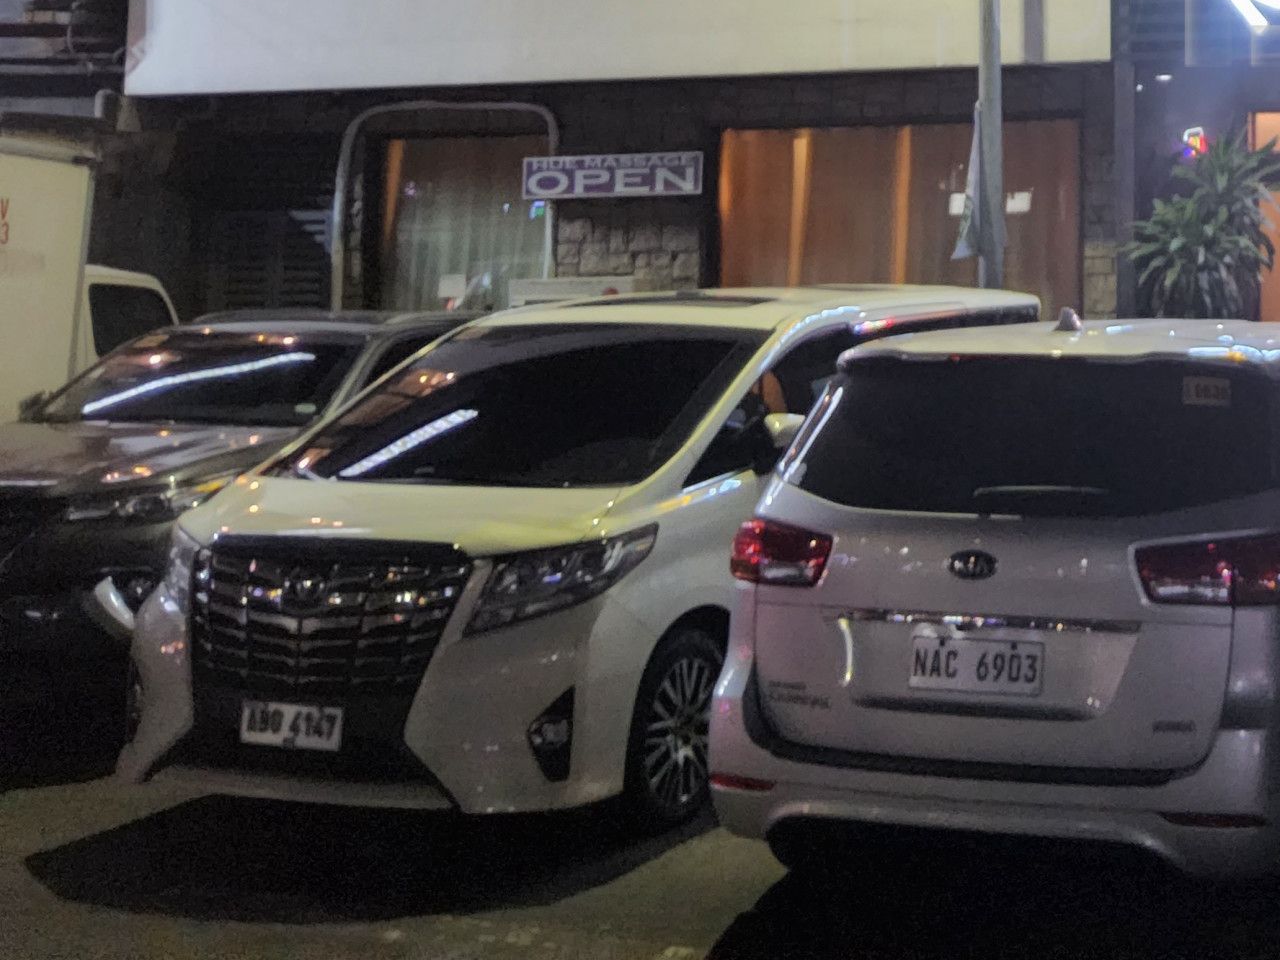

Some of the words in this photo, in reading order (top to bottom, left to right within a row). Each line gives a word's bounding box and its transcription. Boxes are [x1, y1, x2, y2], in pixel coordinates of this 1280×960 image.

[583, 153, 697, 169] MASSAGE
[527, 166, 695, 196] OPEN
[913, 648, 959, 679] NAC
[975, 652, 1039, 684] 6903
